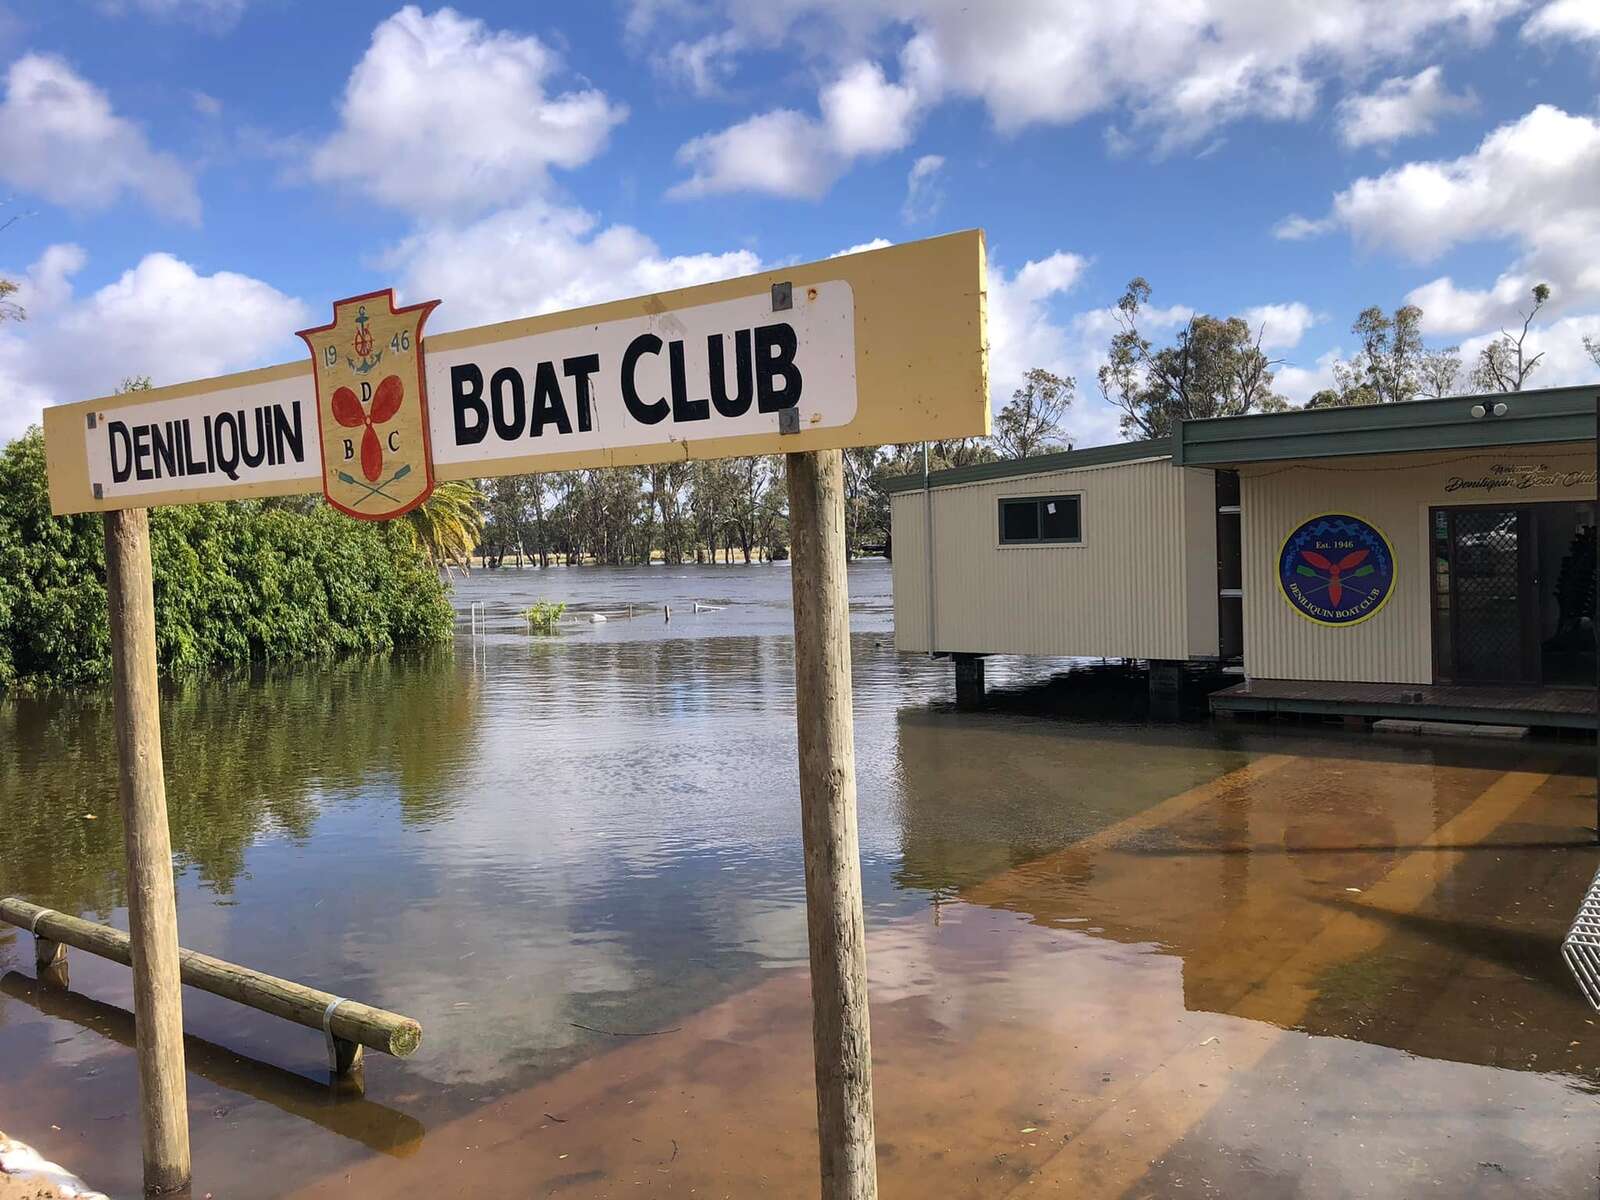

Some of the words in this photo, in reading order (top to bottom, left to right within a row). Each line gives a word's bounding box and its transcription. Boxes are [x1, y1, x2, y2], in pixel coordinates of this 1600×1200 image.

[324, 345, 338, 367] 19
[391, 330, 410, 353] 46
[108, 401, 304, 483] DENILIQUIN
[450, 353, 600, 446] BOAT
[620, 322, 803, 425] CLUB
[361, 381, 372, 402] D
[343, 439, 355, 460] B
[388, 431, 401, 452] C
[1334, 540, 1354, 549] 1946
[1289, 582, 1337, 618] DENILIQUIN
[1336, 604, 1362, 618] BOAT
[1360, 587, 1381, 610] CLUB
